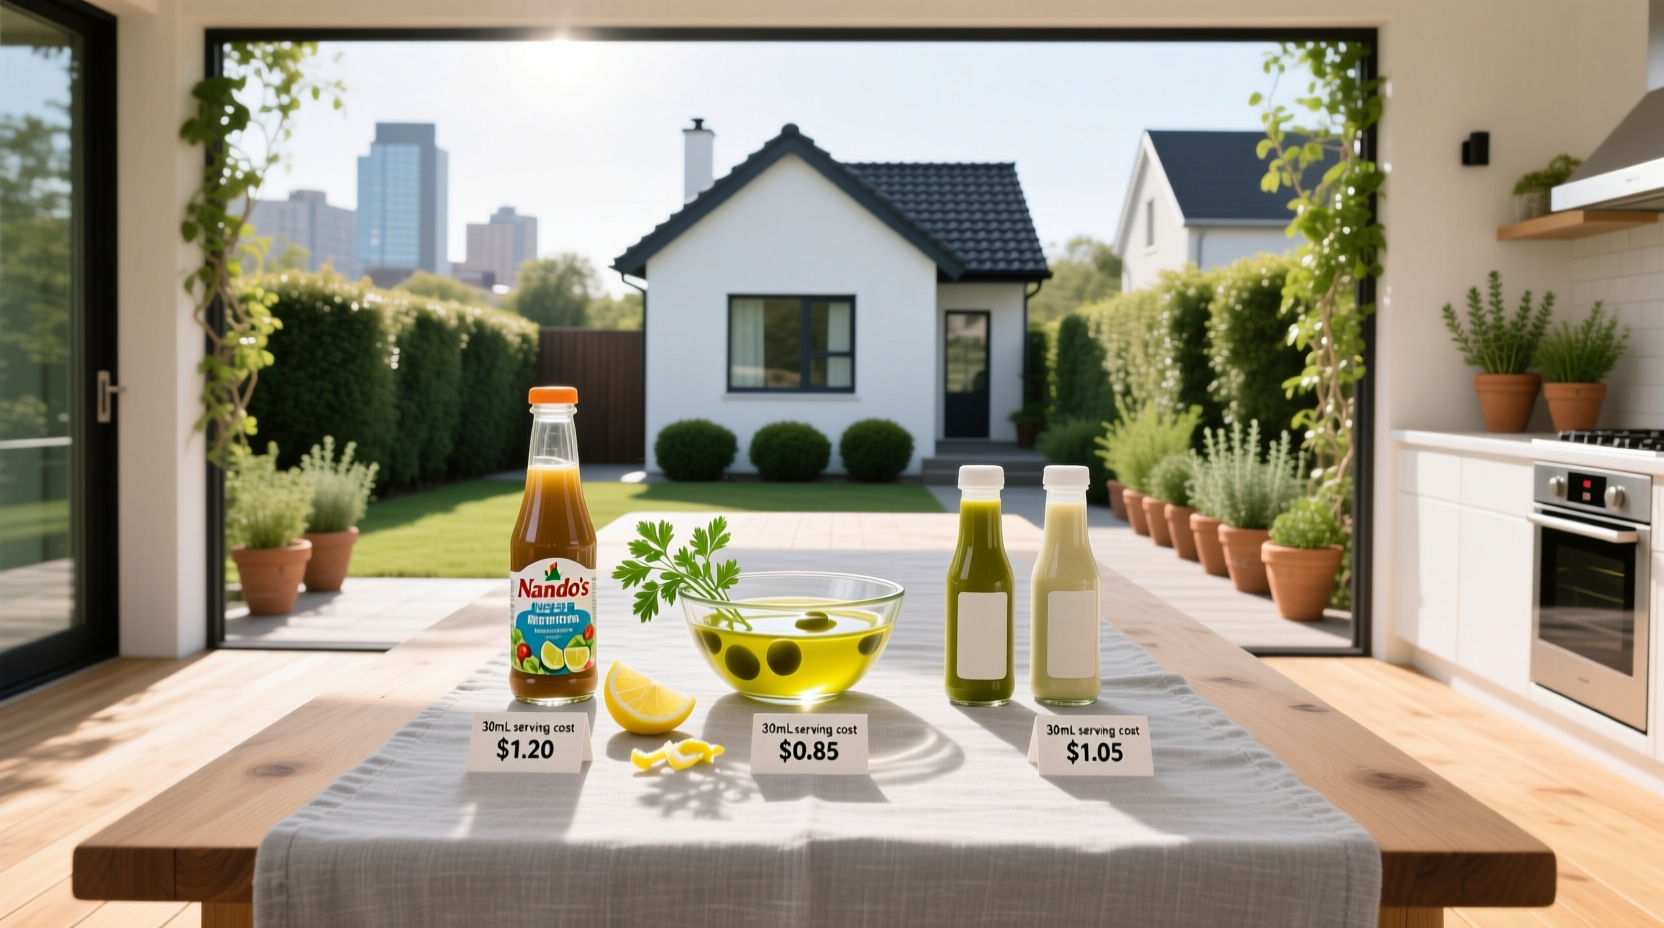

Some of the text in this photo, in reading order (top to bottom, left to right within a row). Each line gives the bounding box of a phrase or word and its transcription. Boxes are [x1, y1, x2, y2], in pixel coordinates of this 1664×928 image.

[517, 577, 590, 598] Nando's
[482, 721, 575, 735] 30mL serving cost
[762, 723, 858, 737] 30mL serving cost
[1046, 724, 1075, 736] 30mL
[1078, 724, 1116, 738] serving
[496, 737, 554, 761] $1.20
[779, 738, 839, 763] $0.85
[1067, 739, 1123, 765] $1.05
